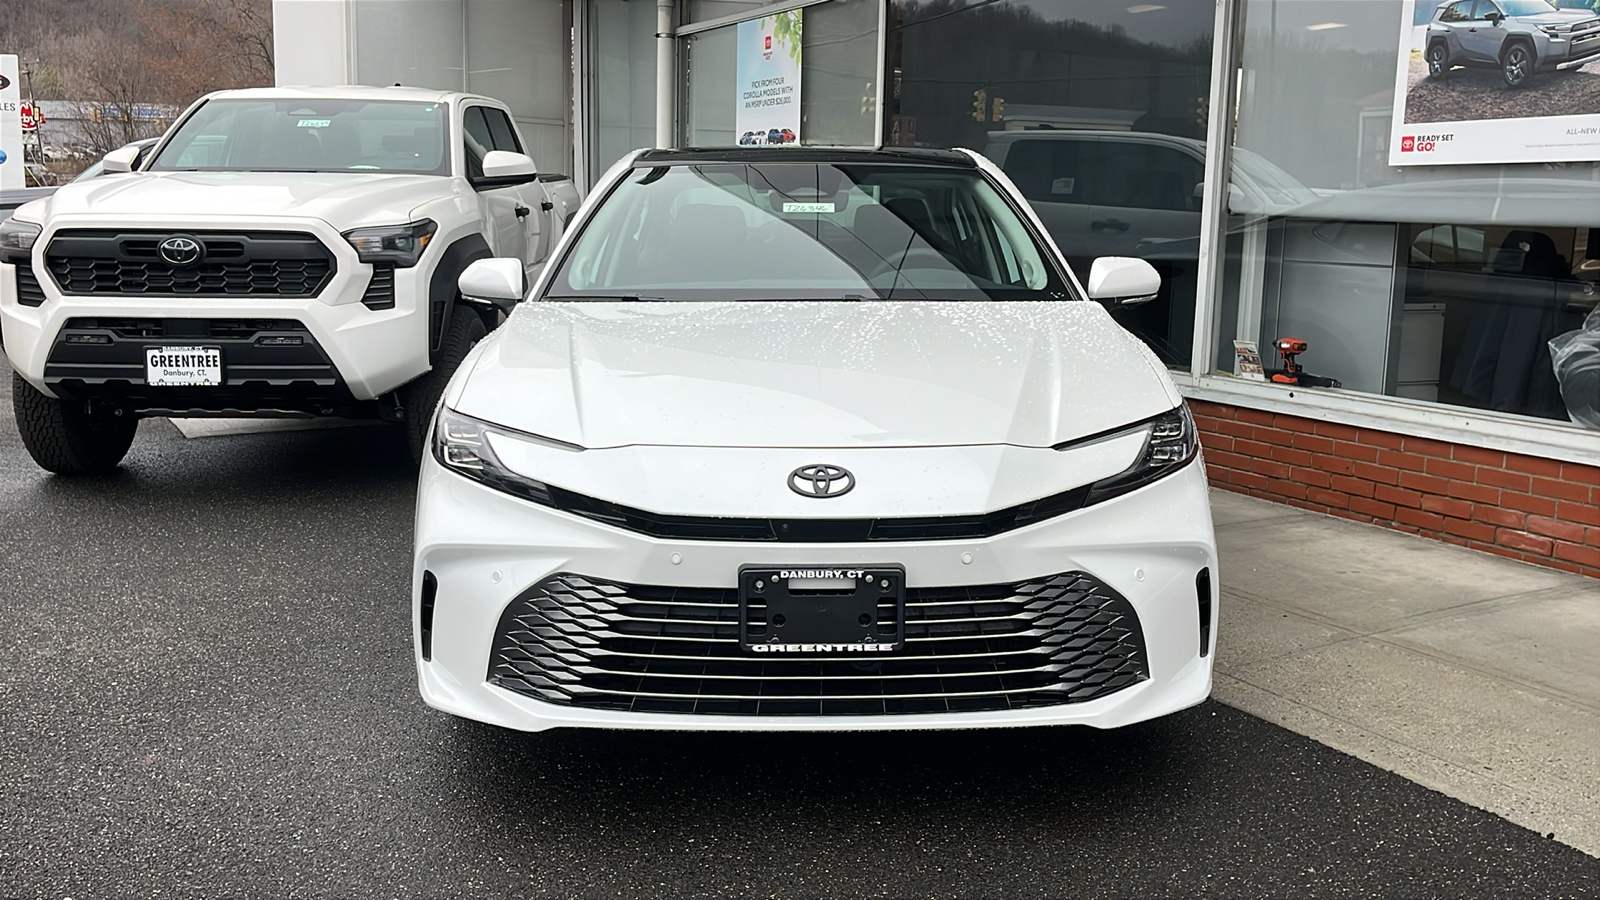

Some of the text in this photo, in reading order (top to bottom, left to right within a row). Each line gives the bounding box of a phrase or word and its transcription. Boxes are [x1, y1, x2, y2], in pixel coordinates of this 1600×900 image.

[751, 77, 784, 88] PICK FROM FOUR
[743, 85, 794, 99] COROLLA MODELS WITH
[762, 97, 776, 107] UNDER
[1565, 127, 1598, 135] ALL-NEW
[1417, 133, 1454, 142] READY SET
[1416, 142, 1435, 152] GO!
[150, 354, 219, 368] GREENTREE
[163, 368, 207, 378] Danbury, CT.
[780, 570, 865, 580] DANBURY, CT
[751, 643, 894, 653] GREENTREE
